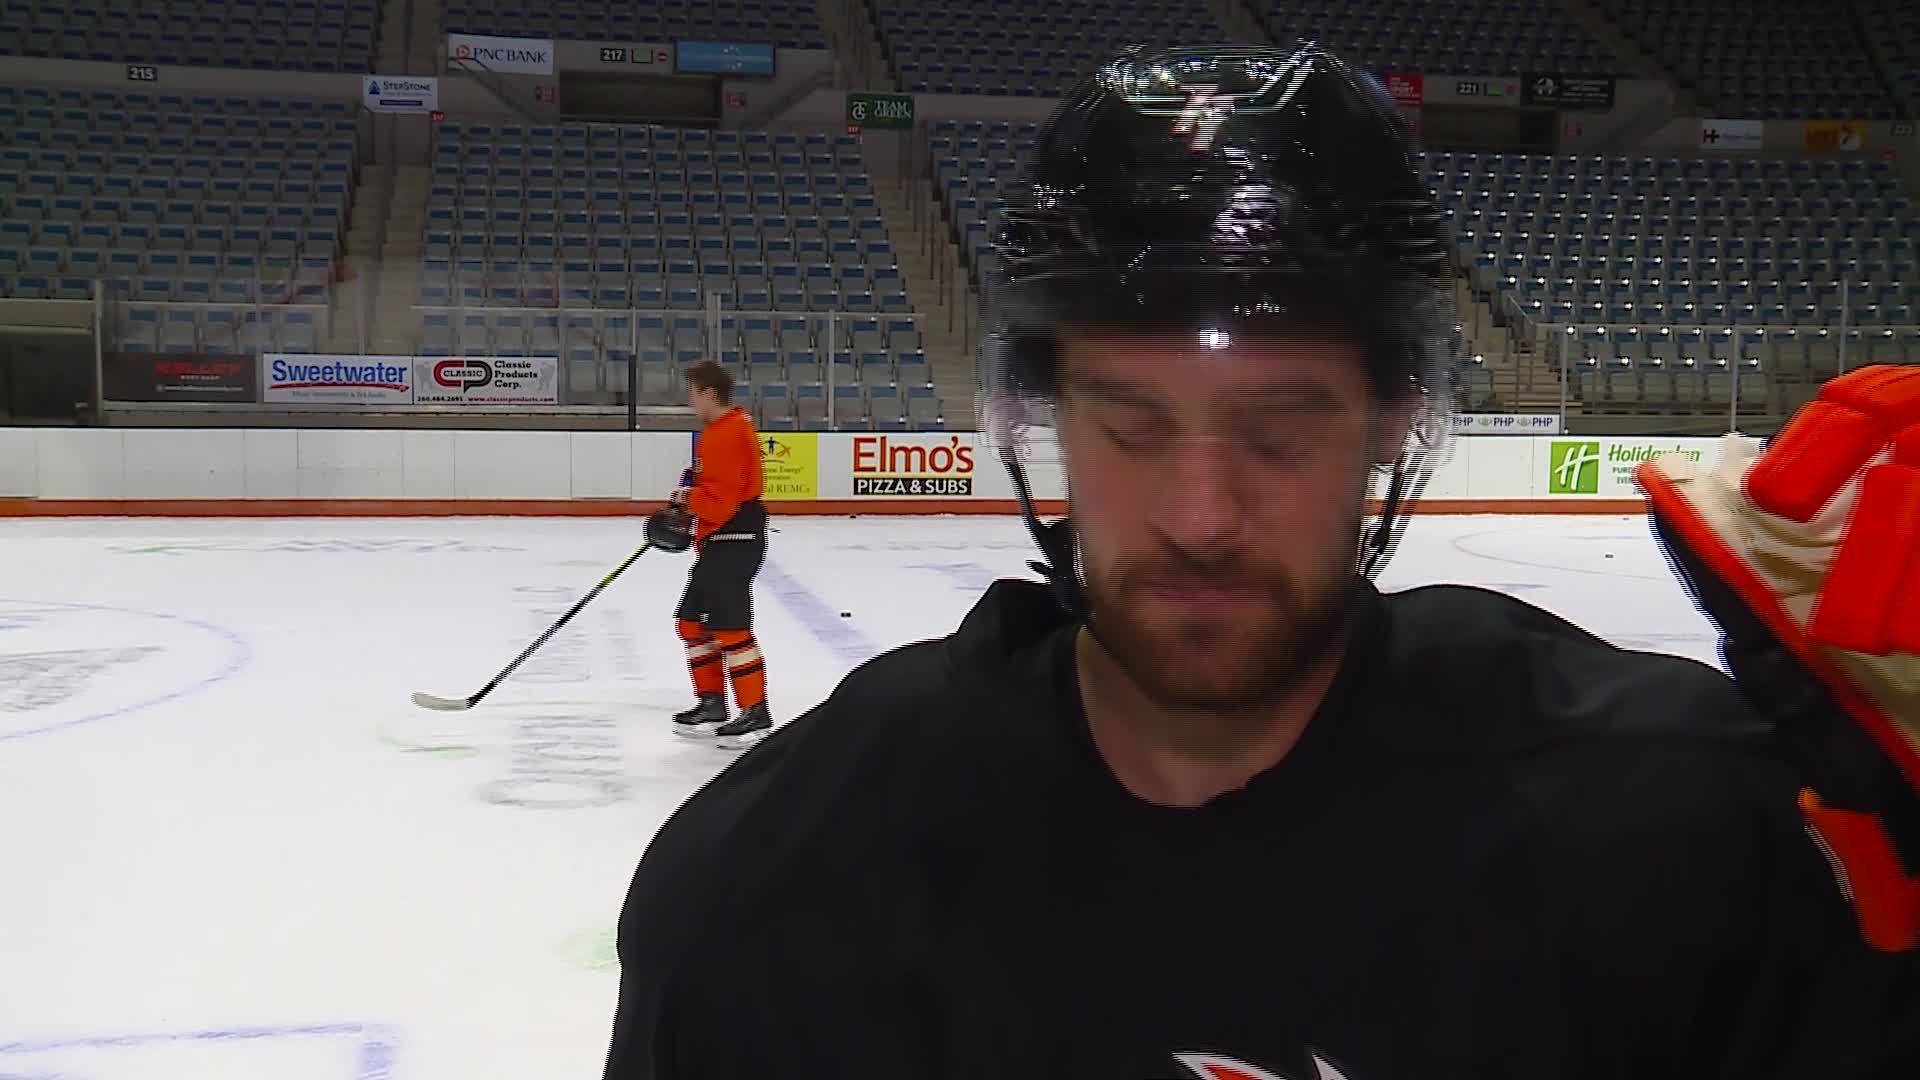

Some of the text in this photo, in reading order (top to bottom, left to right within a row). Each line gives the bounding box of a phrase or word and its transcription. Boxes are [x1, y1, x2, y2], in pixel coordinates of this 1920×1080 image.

[473, 46, 547, 64] PNC BANK
[603, 49, 623, 61] 217
[130, 66, 153, 79] 215
[1459, 83, 1477, 95] 221
[874, 99, 908, 110] TEAM
[494, 360, 532, 369] Classic
[272, 359, 408, 383] Sweetwater
[443, 370, 483, 378] CLASSIC
[494, 370, 538, 379] Products
[494, 380, 522, 390] Corp.
[1493, 416, 1514, 427] PHP
[1532, 416, 1553, 427] PHP
[857, 479, 968, 494] PIZZA & SUBS
